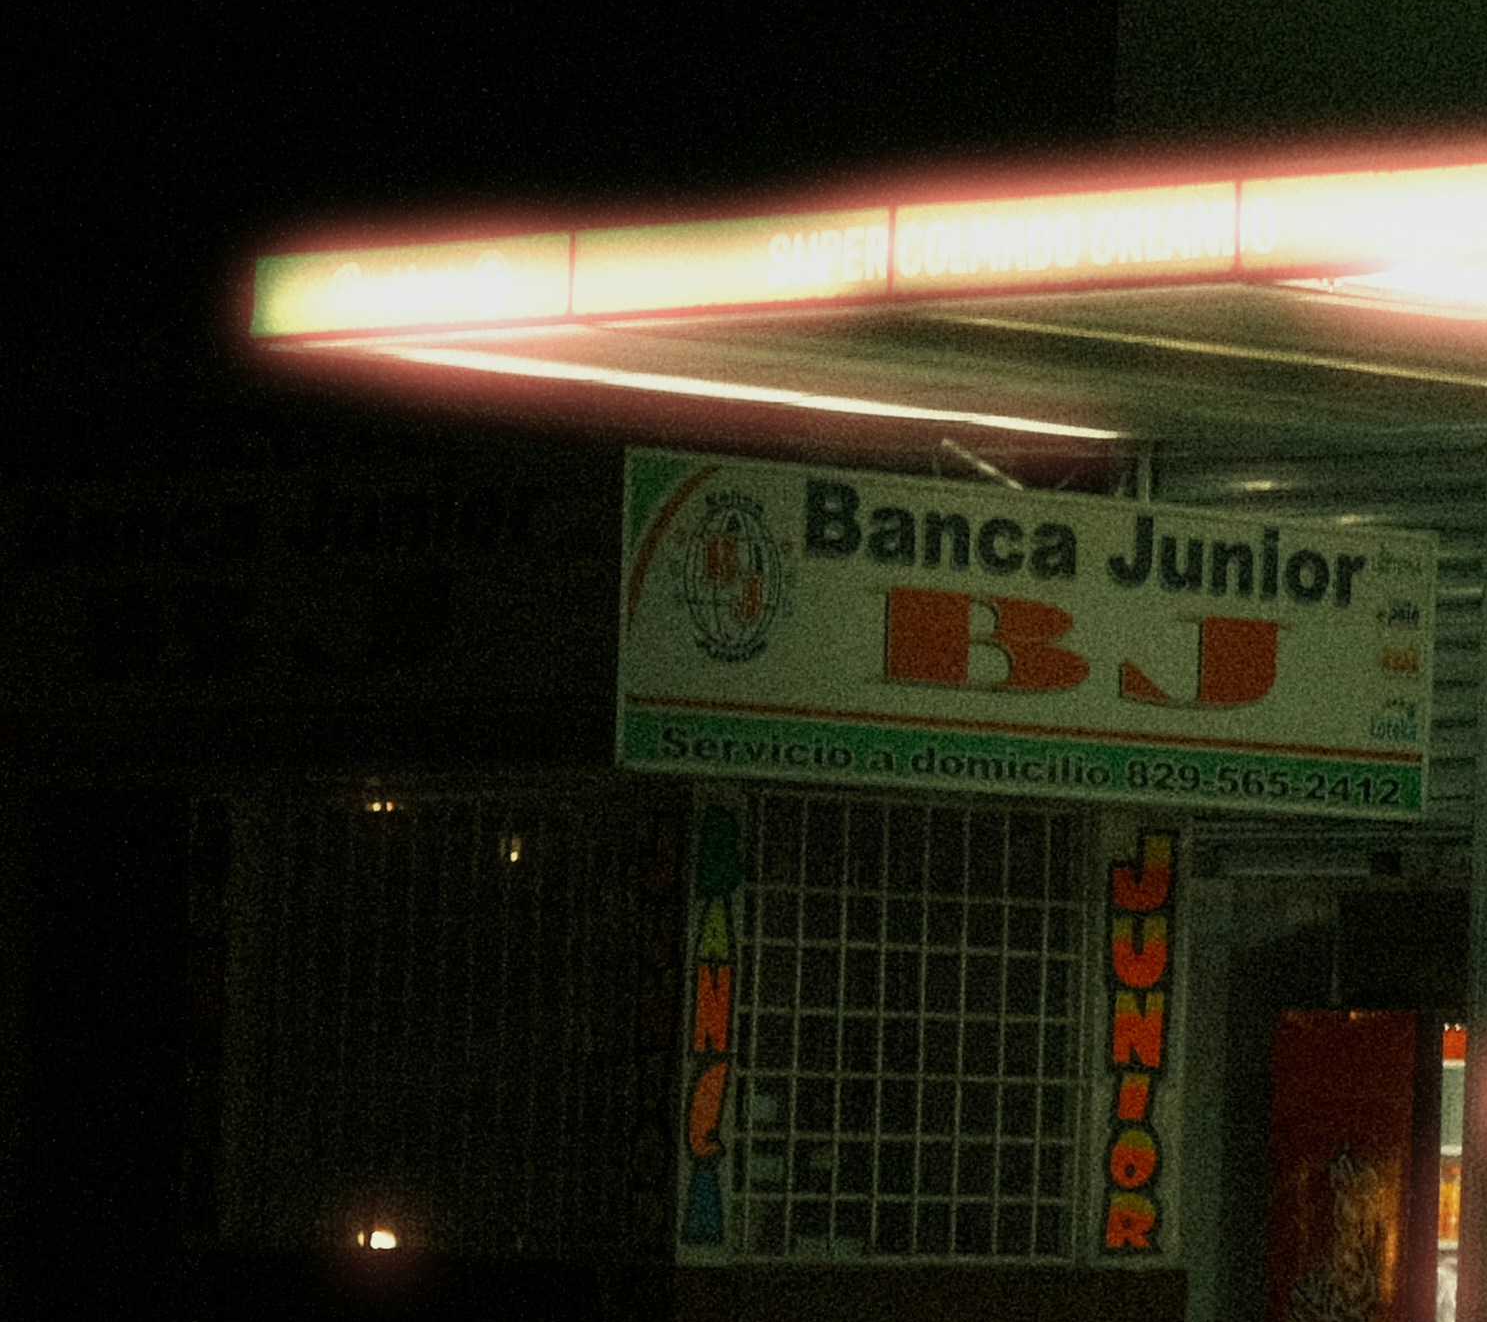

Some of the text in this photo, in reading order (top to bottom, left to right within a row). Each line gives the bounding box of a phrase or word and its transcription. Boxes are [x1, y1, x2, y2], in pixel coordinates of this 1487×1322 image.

[767, 225, 890, 288] SUPER
[899, 212, 1082, 279] COLMADO
[804, 479, 1368, 606] Banca Junior
[660, 724, 853, 770] Servicio
[869, 749, 897, 774] a
[908, 741, 1112, 790] domicilio
[1125, 755, 1402, 809] 829-565-2412
[1105, 830, 1180, 1250] JUNIOR
